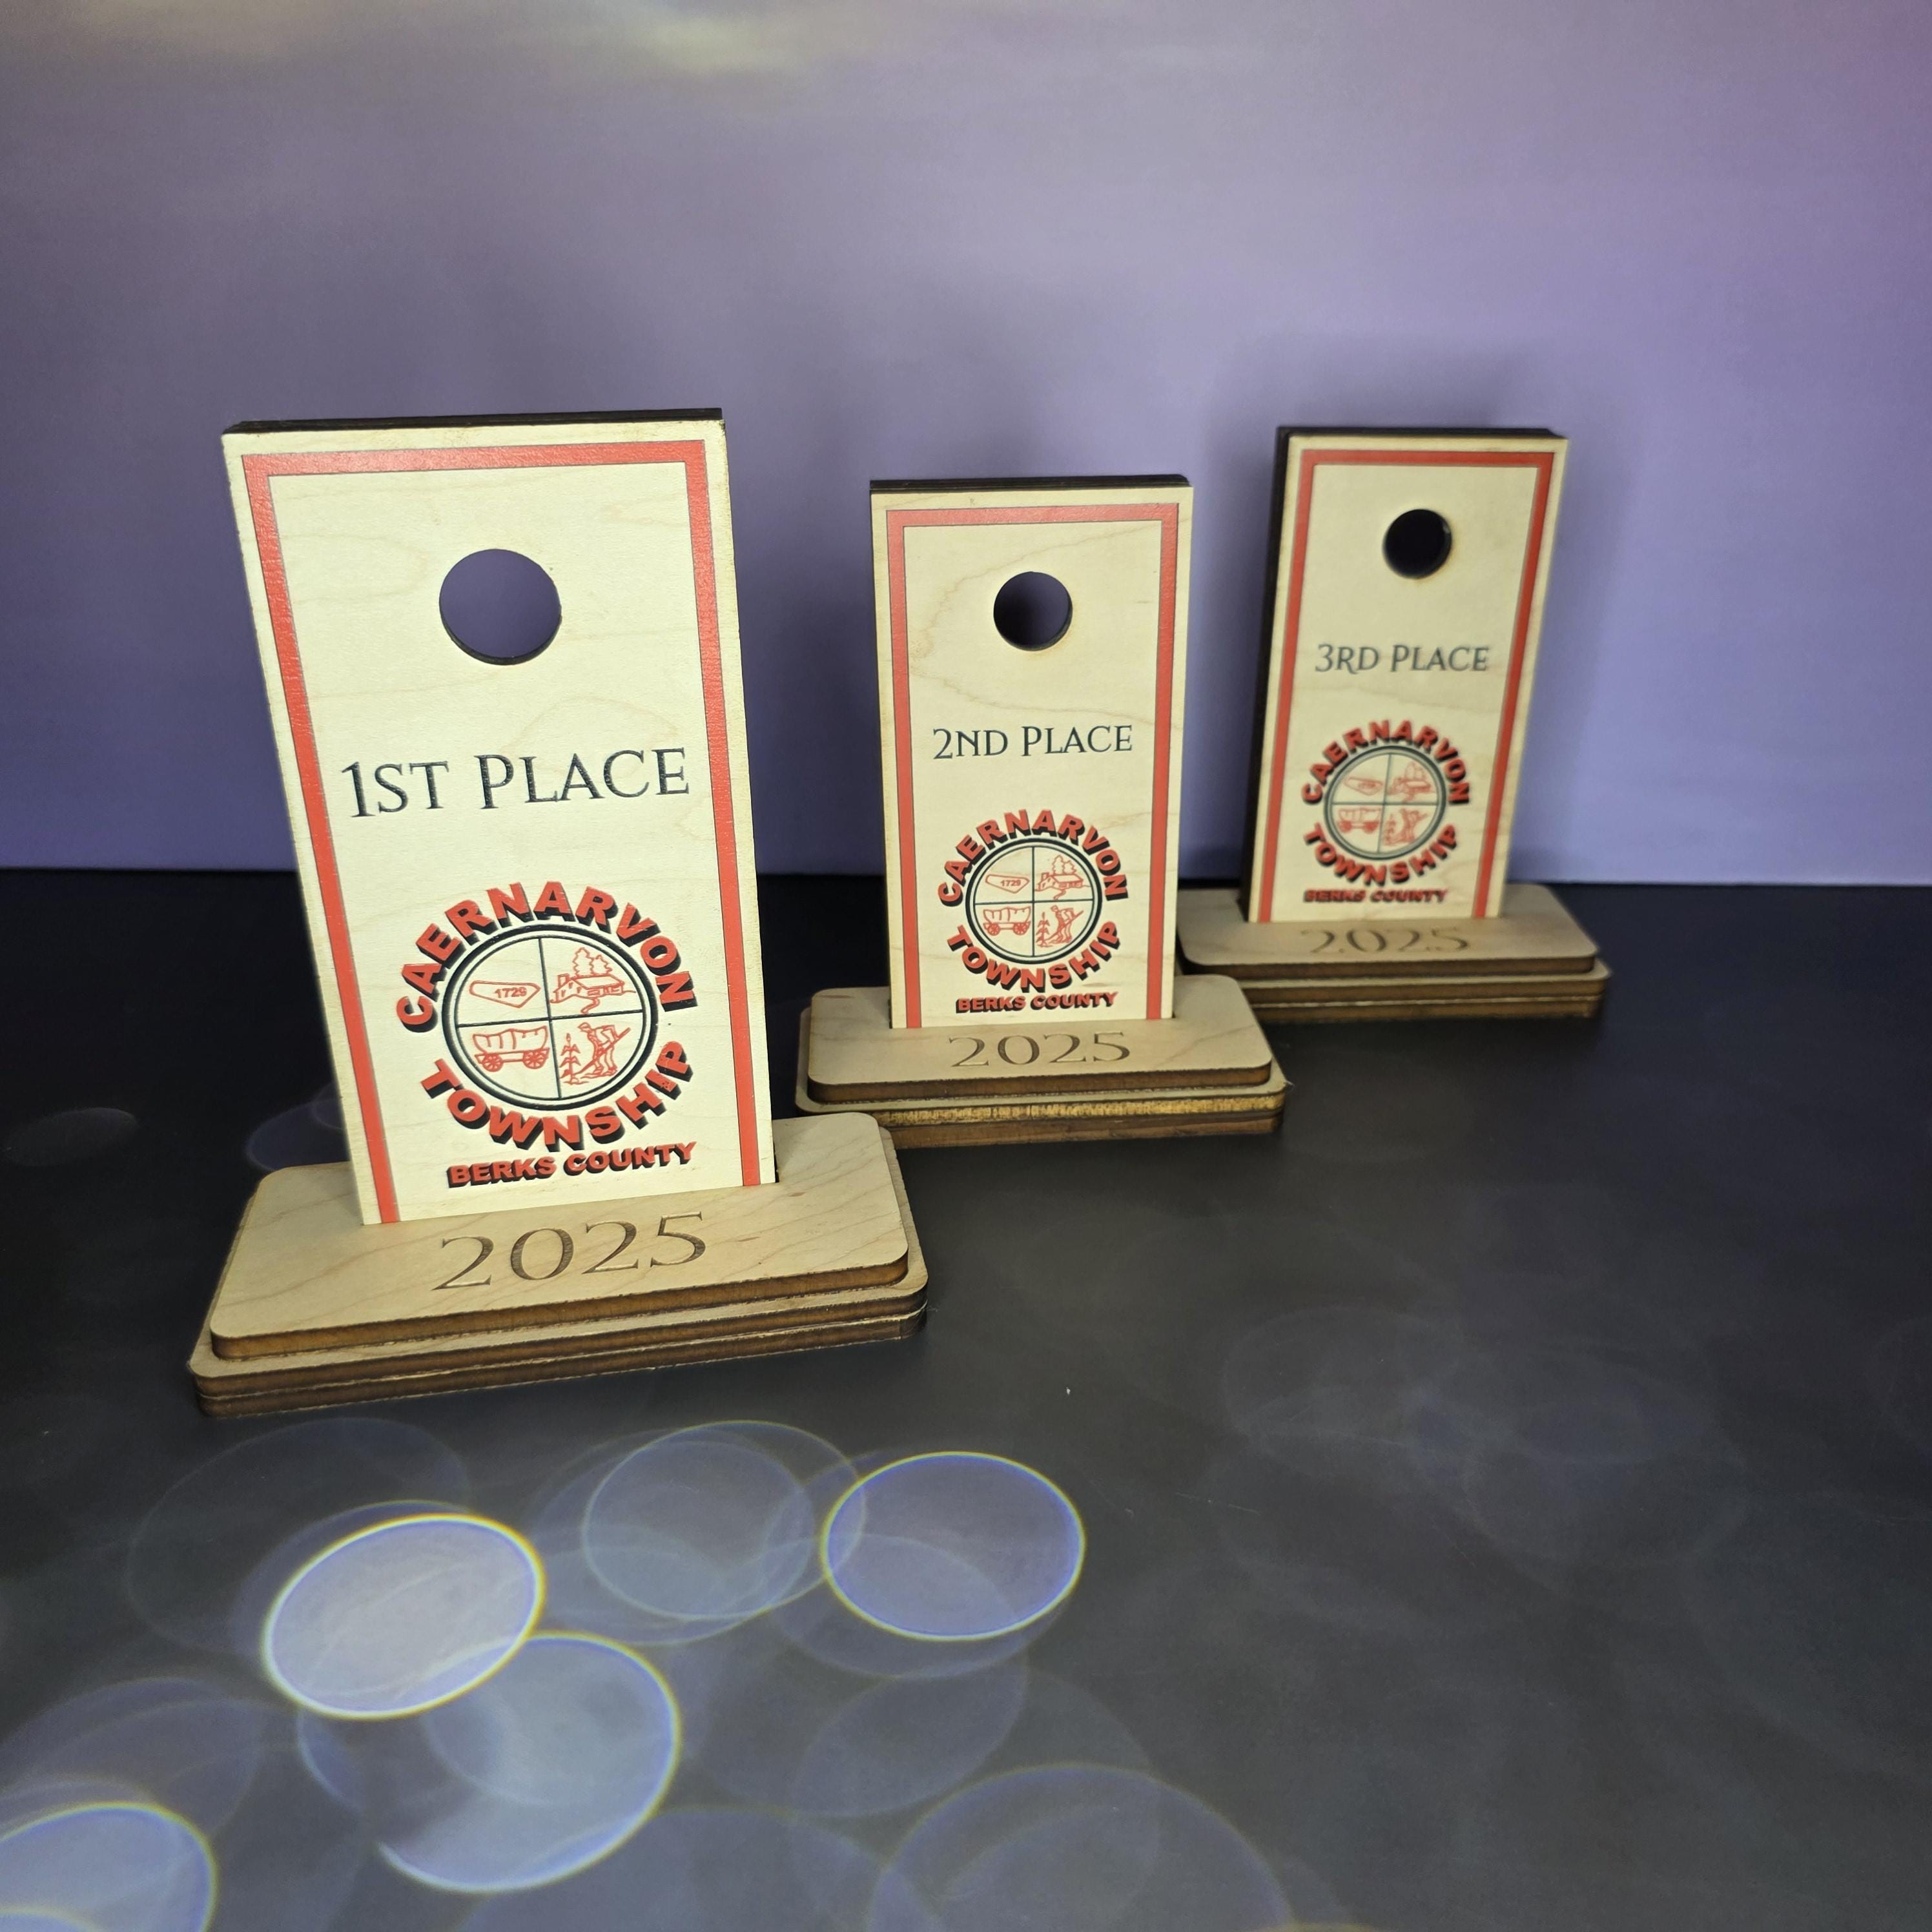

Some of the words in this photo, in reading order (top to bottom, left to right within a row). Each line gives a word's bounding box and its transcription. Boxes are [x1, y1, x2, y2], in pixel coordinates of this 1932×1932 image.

[1315, 643, 1379, 674] 3RD
[1390, 644, 1491, 672] PLACE
[933, 728, 1008, 759] 2ND
[1021, 724, 1133, 757] PLACE
[1301, 719, 1470, 805] CAERNARVON
[342, 760, 449, 817] 1ST
[474, 748, 690, 809] PLACE
[937, 808, 1129, 907] CAERNARVON
[1303, 822, 1459, 887] TOWNSHIP
[1000, 878, 1021, 887] 1729
[1302, 889, 1365, 903] BERKS
[1370, 889, 1448, 903] COUNTY
[396, 881, 697, 1033] CAERNARVON
[947, 920, 1121, 992] TOWNSHIP
[1301, 928, 1470, 954] 2025
[494, 985, 528, 999] 1729
[956, 996, 1027, 1013] BERKS
[1030, 991, 1118, 1009] COUNTY
[949, 1031, 1131, 1067] 2025
[421, 1040, 693, 1152] TOWNSHIP
[447, 1151, 557, 1189] BERKS
[564, 1141, 697, 1175] COUNTY
[432, 1211, 706, 1290] 2025
